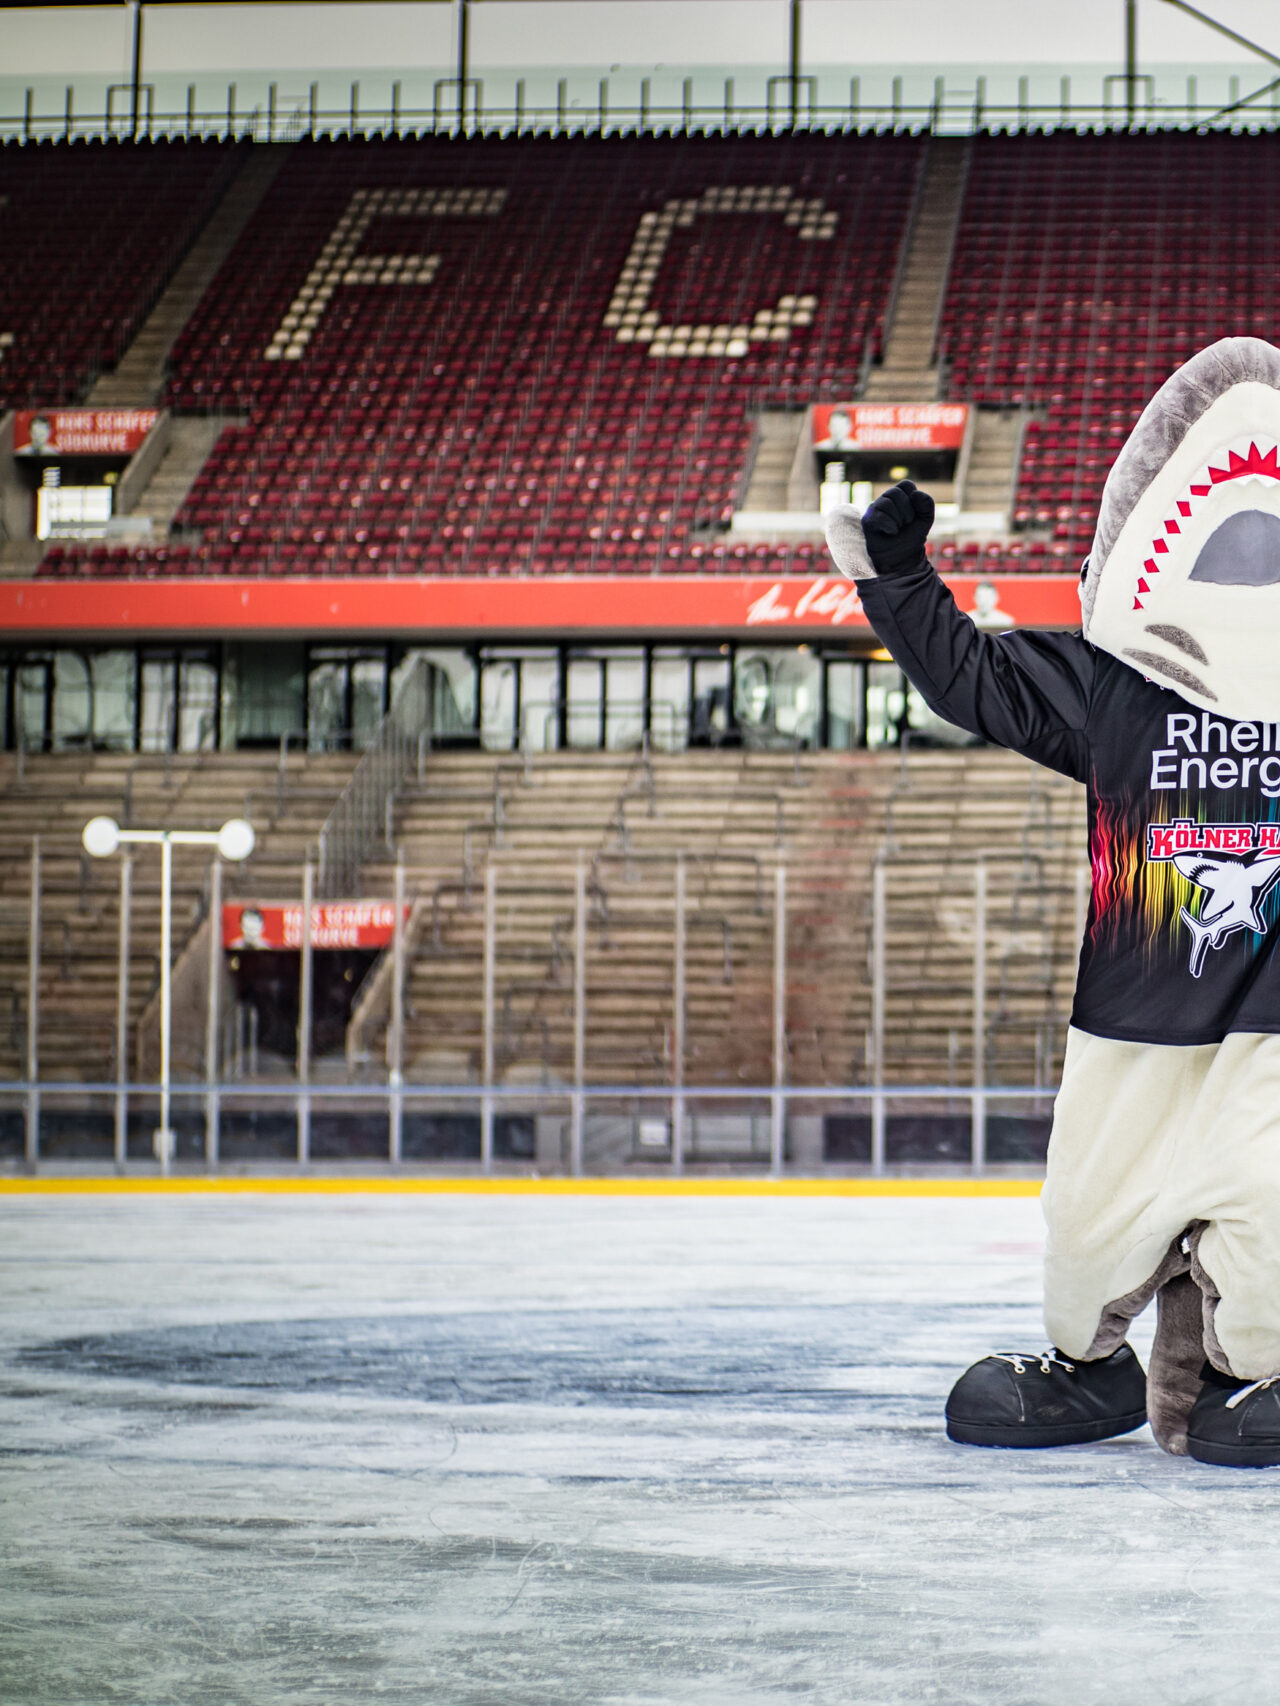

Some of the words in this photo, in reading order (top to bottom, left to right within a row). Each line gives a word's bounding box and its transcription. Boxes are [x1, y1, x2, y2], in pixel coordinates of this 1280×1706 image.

[1152, 823, 1253, 857] KÖLNER
[283, 906, 322, 927] HAS
[283, 927, 359, 947] SÜKURVE
